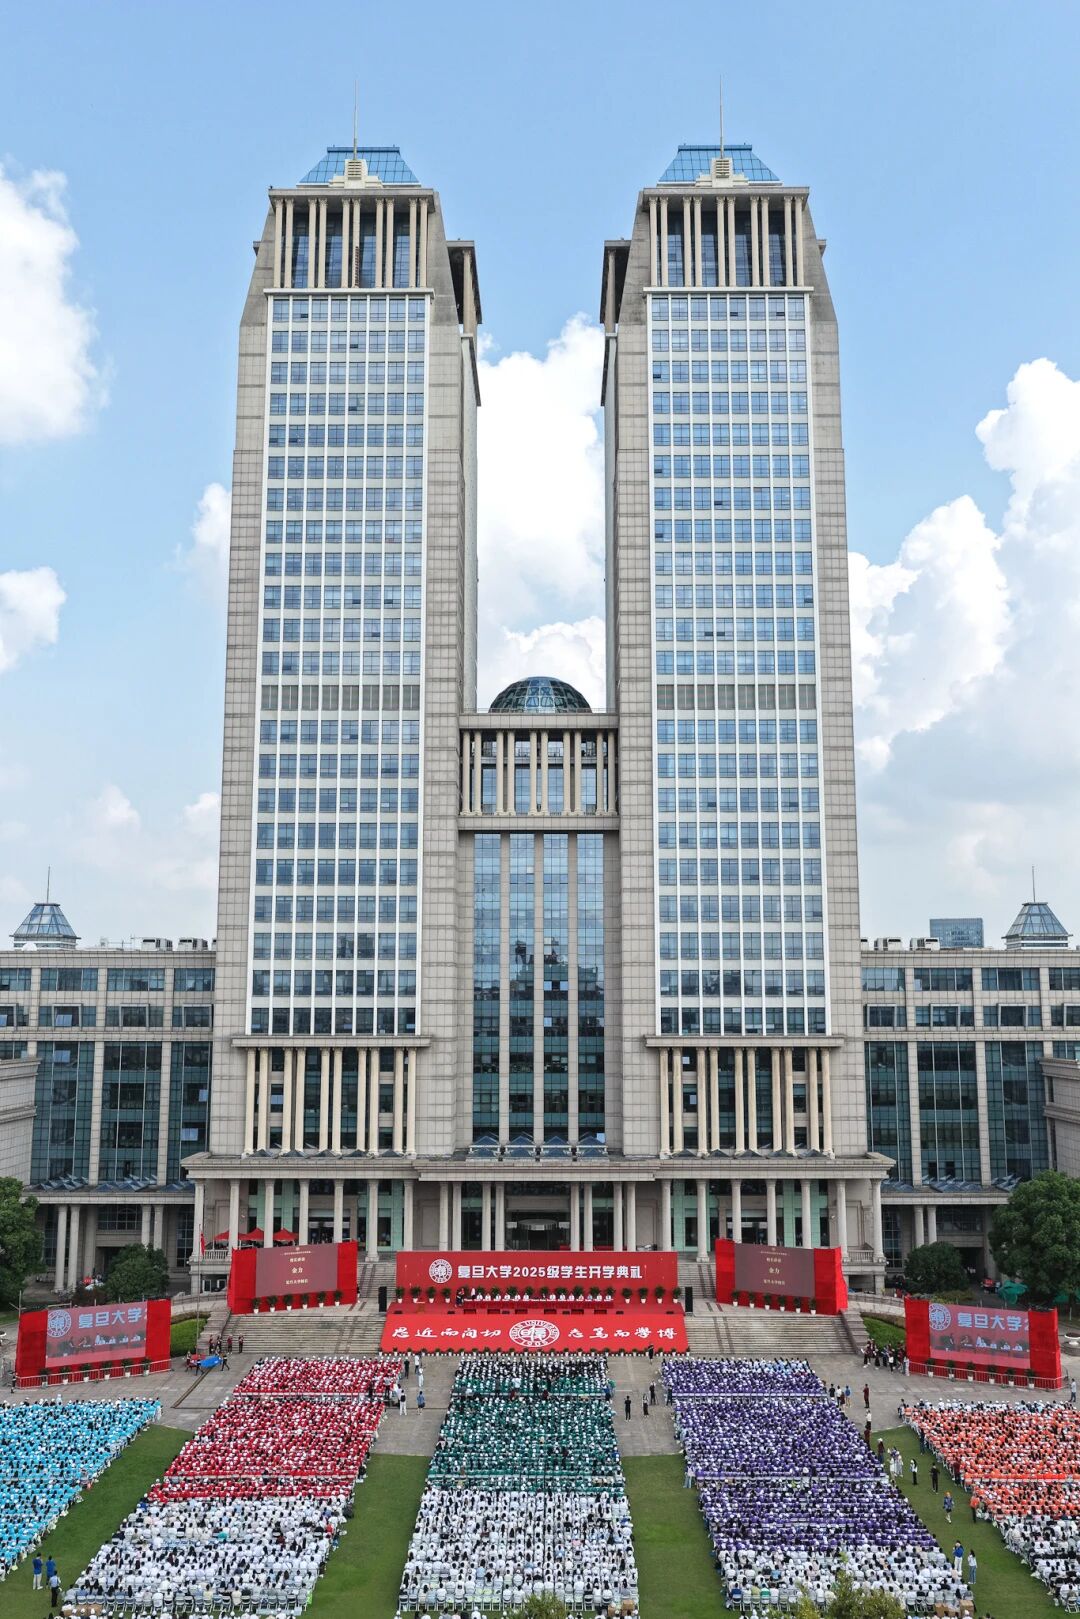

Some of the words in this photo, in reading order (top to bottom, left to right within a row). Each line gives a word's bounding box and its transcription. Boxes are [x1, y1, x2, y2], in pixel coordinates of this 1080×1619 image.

[457, 1265, 643, 1279] 复旦大学2025级学生开学典礼
[78, 1307, 147, 1329] 复旦大学
